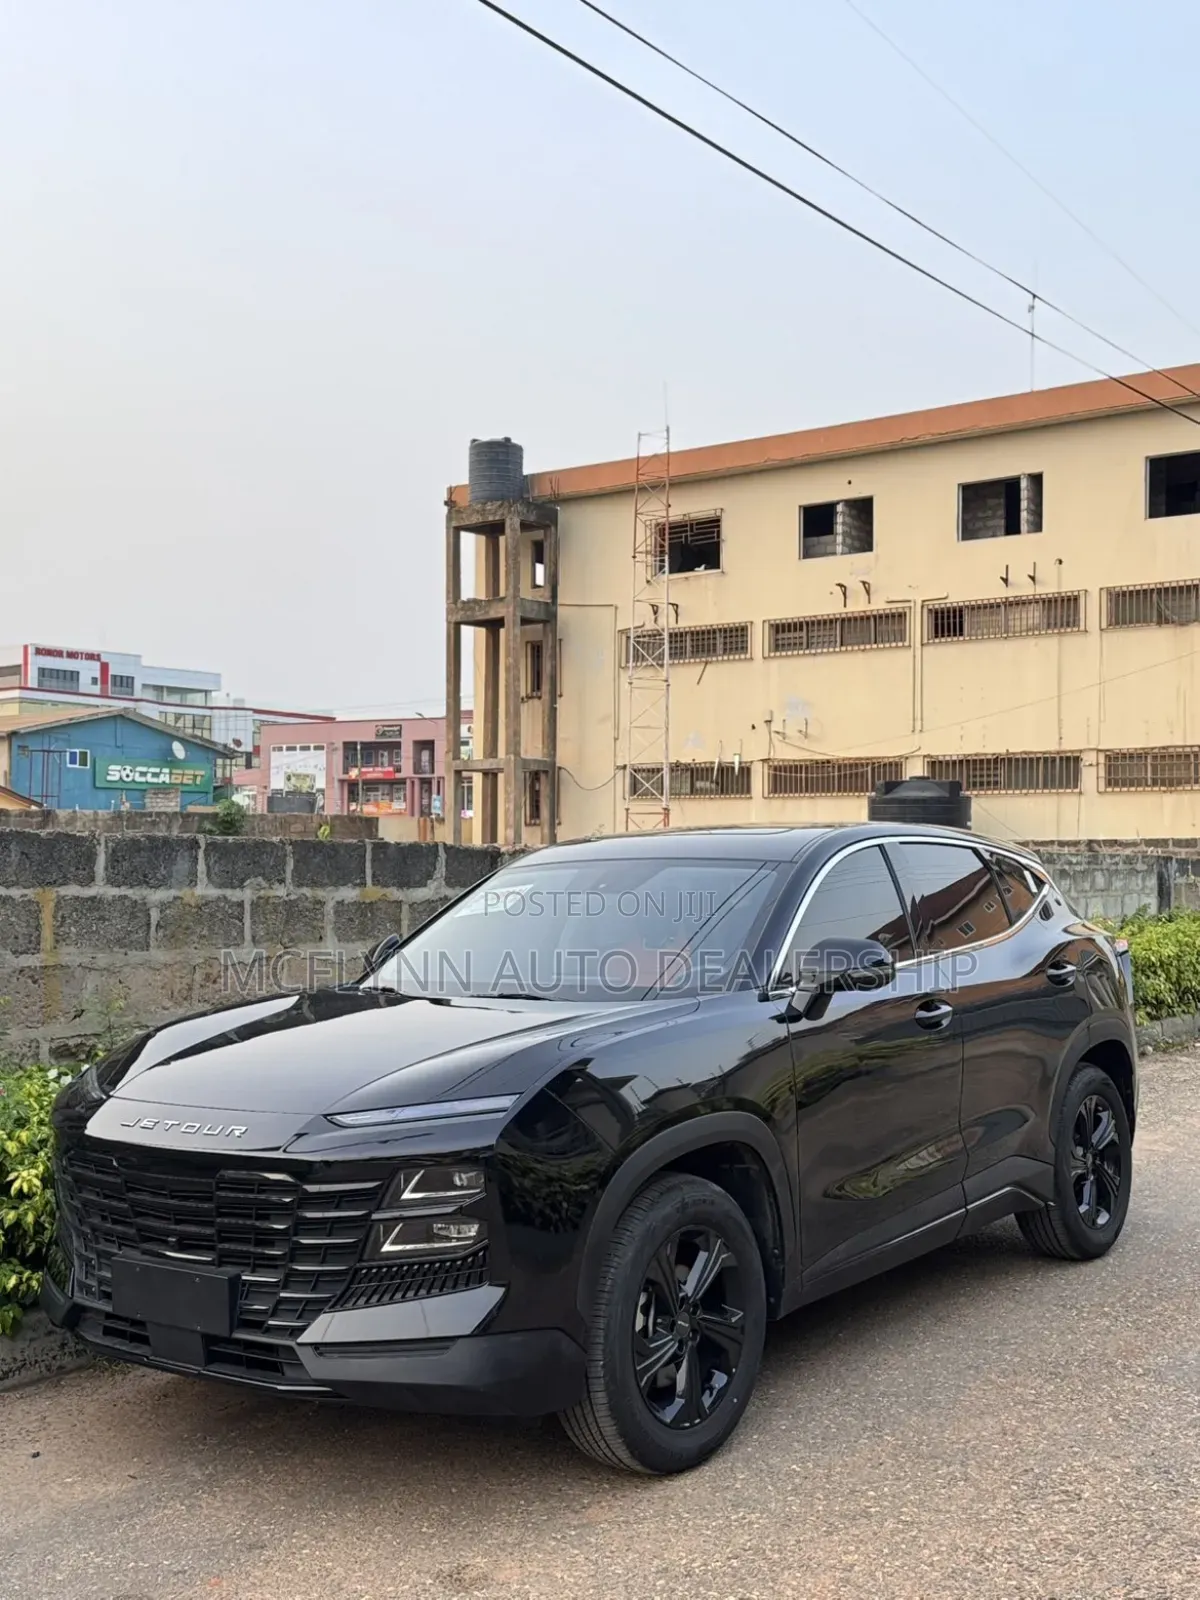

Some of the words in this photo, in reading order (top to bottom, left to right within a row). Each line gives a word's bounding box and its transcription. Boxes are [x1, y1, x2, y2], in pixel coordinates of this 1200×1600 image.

[66, 650, 101, 662] MOTORS
[106, 764, 205, 786] SOCCABET
[120, 1117, 249, 1138] JETOUR
